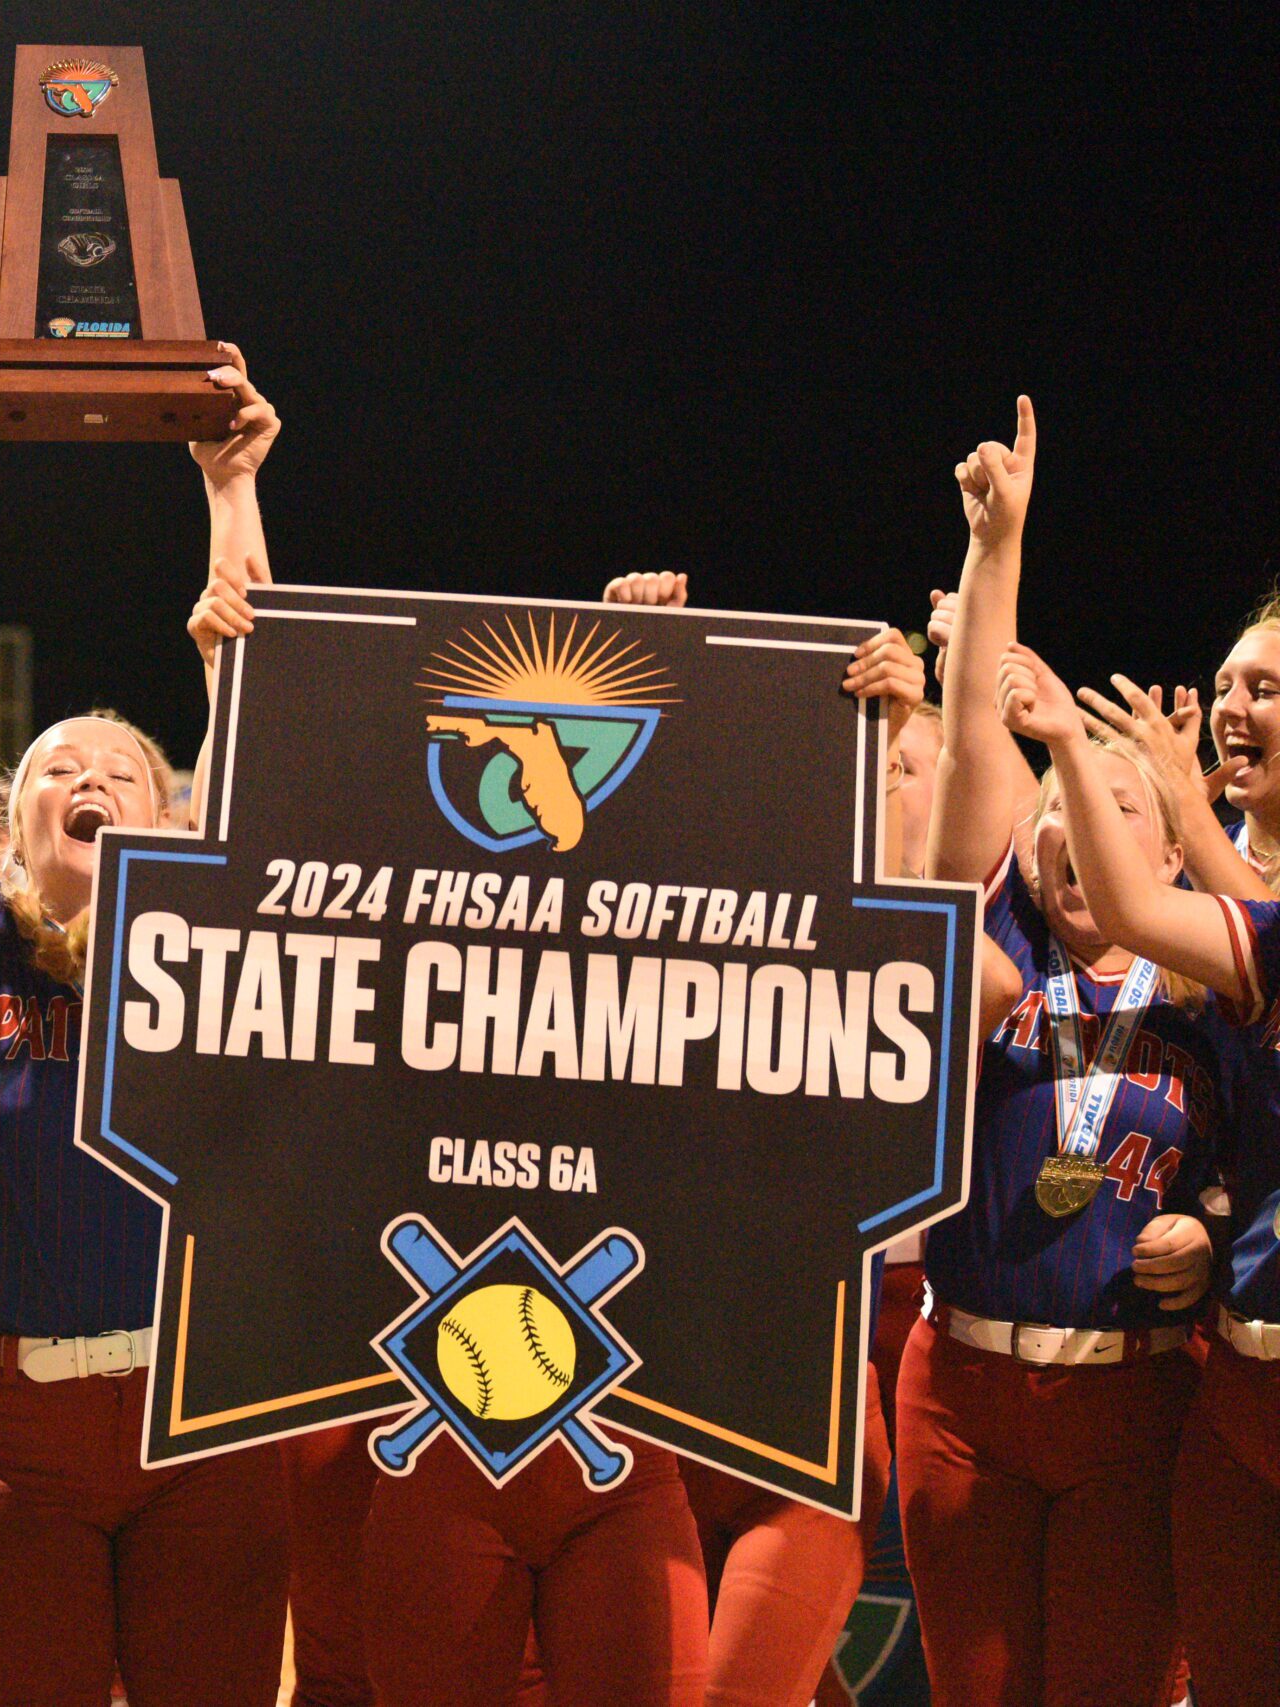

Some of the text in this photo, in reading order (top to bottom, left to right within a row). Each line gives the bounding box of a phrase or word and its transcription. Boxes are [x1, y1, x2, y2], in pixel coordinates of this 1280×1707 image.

[76, 322, 130, 332] FLORIDA
[257, 859, 818, 951] 2024 FHSAA SOFTBALL
[123, 911, 935, 1104] STATE CHAMPIONS
[1128, 961, 1154, 1008] SOFTB
[428, 1136, 598, 1194] CLASS 6A
[1105, 1131, 1184, 1210] 44
